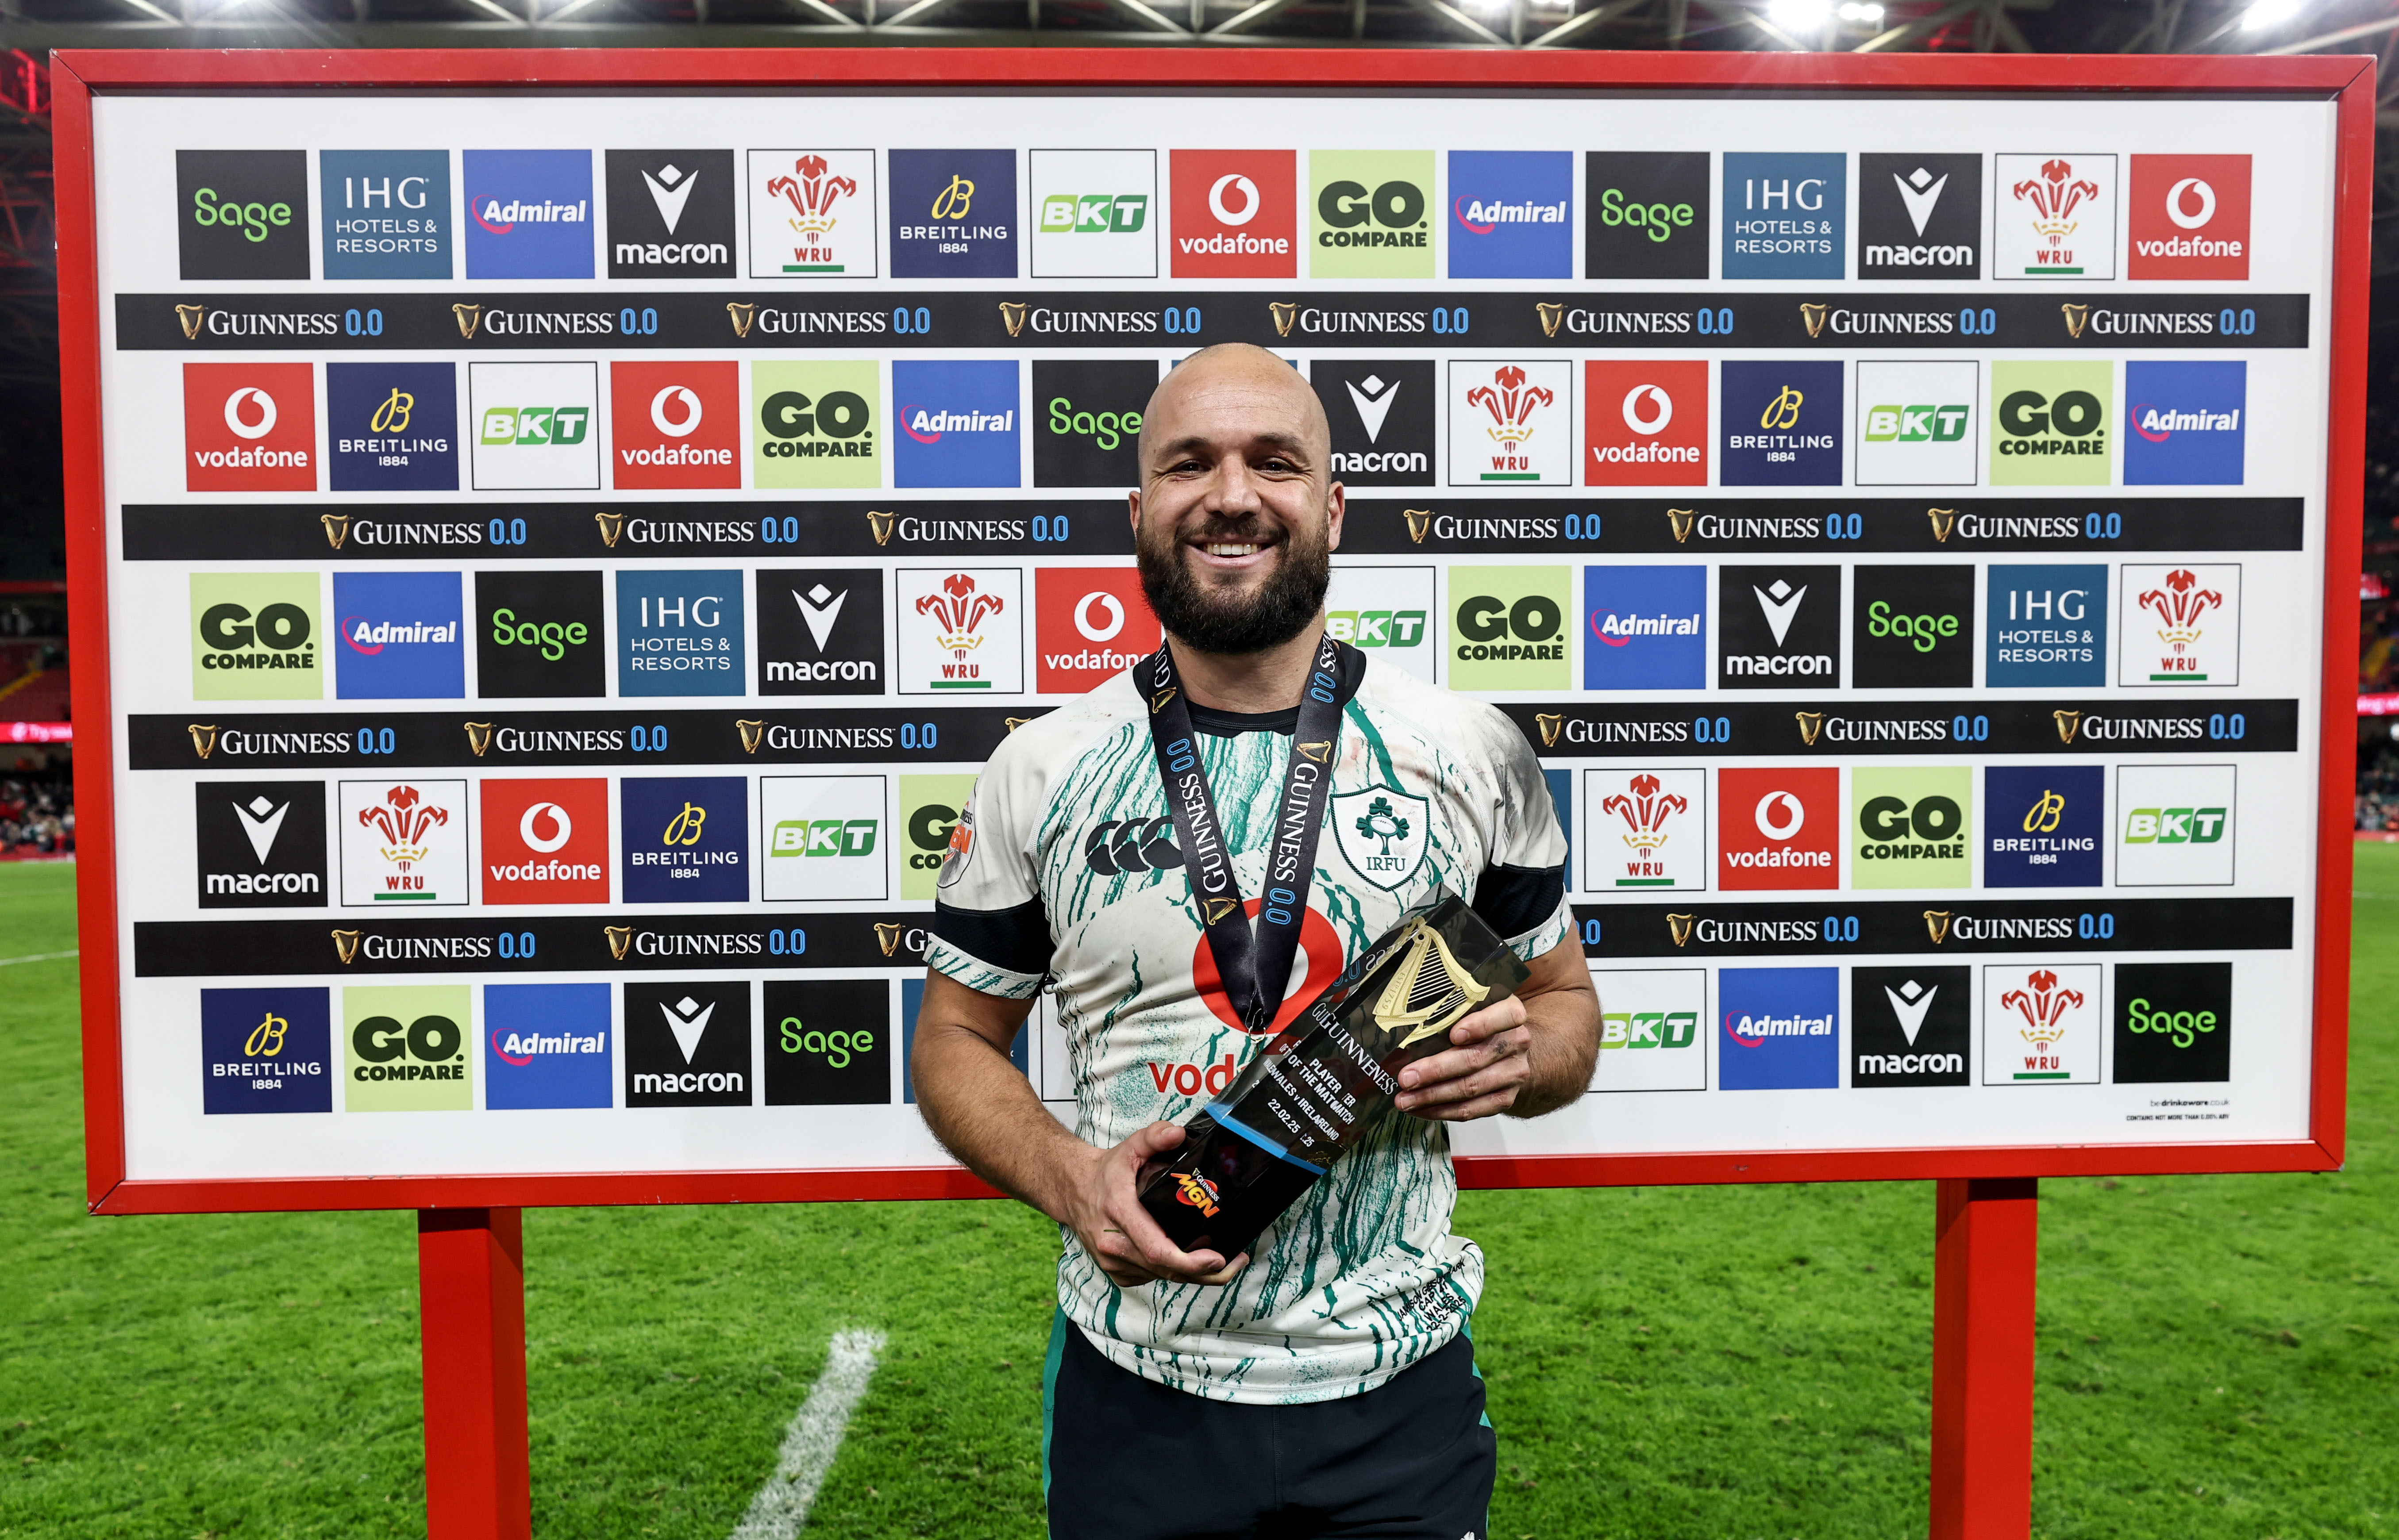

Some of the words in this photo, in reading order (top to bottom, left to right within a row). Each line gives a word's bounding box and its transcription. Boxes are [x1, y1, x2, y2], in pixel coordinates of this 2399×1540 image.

[346, 177, 426, 209] IHG
[1318, 181, 1427, 228] GO.
[1746, 179, 1823, 211] IHG
[195, 188, 293, 243] Sage
[483, 200, 586, 223] Admiral
[1042, 198, 1145, 229] BKT
[1466, 200, 1566, 223] Admiral
[1602, 189, 1694, 242] Sage
[336, 219, 420, 234] HOTELS
[424, 219, 437, 233] &
[900, 226, 1007, 239] BREITLING
[1735, 220, 1815, 234] HOTELS
[1819, 220, 1832, 234] &
[336, 238, 437, 253] RESORTS
[939, 243, 968, 253] 1884
[1179, 232, 1289, 254] vodafone
[1319, 231, 1426, 247] COMPARE
[1735, 239, 1832, 253] RESORTS
[795, 248, 831, 261] WRU
[1866, 246, 1973, 265] macron
[2037, 251, 2072, 264] WRU
[208, 310, 338, 335] GUINNESS
[345, 308, 383, 336] 0.0
[759, 308, 886, 333] GUINNESS
[893, 307, 931, 334] 0.0
[1031, 308, 1157, 333] GUINNESS
[1164, 307, 1201, 334] 0.0
[1567, 309, 1690, 333] GUINNESS
[1697, 307, 1734, 335] 0.0
[1830, 309, 1953, 334] GUINNESS
[1960, 307, 1996, 335] 0.0
[761, 391, 872, 439] GO.
[911, 410, 1013, 433] Admiral
[1049, 397, 1143, 450] Sage
[1999, 391, 2104, 437] GO.
[2141, 408, 2240, 431] Admiral
[483, 411, 586, 442] BKT
[339, 438, 447, 453] BREITLING
[763, 442, 872, 457] COMPARE
[1593, 442, 1700, 463] vodafone
[1730, 435, 1833, 449] BREITLING
[1999, 440, 2103, 455] COMPARE
[195, 445, 308, 468] vodafone
[379, 456, 408, 466] 1884
[621, 443, 732, 465] vodafone
[1492, 457, 1528, 470] WRU
[1767, 452, 1796, 462] 1884
[353, 520, 481, 545] GUINNESS
[489, 518, 527, 545] 0.0
[627, 519, 754, 543] GUINNESS
[762, 516, 799, 543] 0.0
[1433, 515, 1557, 539] GUINNESS
[1564, 514, 1601, 540] 0.0
[1697, 515, 1819, 538] GUINNESS
[1826, 513, 1862, 540] 0.0
[641, 596, 720, 627] IHG
[2009, 589, 2085, 621] IHG
[200, 603, 314, 650] GO.
[1457, 595, 1563, 642] GO.
[1601, 613, 1700, 636] Admiral
[1868, 600, 1959, 653] Sage
[353, 621, 456, 644] Admiral
[493, 608, 588, 661] Sage
[1999, 630, 2077, 644] HOTELS
[2081, 630, 2094, 644] &
[631, 638, 713, 652] HOTELS
[718, 637, 731, 651] &
[1457, 645, 1563, 661] COMPARE
[1998, 648, 2093, 663] RESORTS
[202, 653, 314, 669] COMPARE
[632, 656, 731, 671] RESORTS
[767, 661, 876, 681] macron
[943, 664, 978, 678] WRU
[1727, 655, 1832, 675] macron
[2162, 658, 2195, 671] WRU
[1310, 672, 1336, 703] 0.0
[496, 728, 623, 752] GUINNESS
[631, 725, 667, 752] 0.0
[1566, 719, 1687, 742] GUINNESS
[1694, 717, 1730, 743] 0.0
[1825, 718, 1946, 741] GUINNESS
[1953, 715, 1989, 741] 0.0
[221, 730, 350, 754] GUINNESS
[358, 727, 395, 754] 0.0
[1167, 738, 1194, 772] 0.0
[1275, 762, 1319, 883] GUINNESS
[1860, 796, 1964, 841] GO.
[2127, 811, 2224, 841] BKT
[1179, 773, 1227, 893] GUINNESS
[1993, 837, 2094, 852] BREITLING
[632, 851, 738, 865] BREITLING
[1726, 846, 1832, 868] vodafone
[1860, 844, 1963, 859] COMPARE
[2029, 854, 2057, 864] 1884
[490, 860, 601, 881] vodafone
[671, 868, 700, 879] 1884
[1366, 856, 1406, 872] IRFU
[1628, 863, 1662, 876] WRU
[207, 873, 319, 894] macron
[386, 876, 423, 890] WRU
[1265, 887, 1296, 925] 0.0
[1575, 919, 1601, 945] .0
[1953, 916, 2072, 939] GUINNESS
[2079, 913, 2114, 939] 0.0
[363, 935, 491, 959] GUINNESS
[498, 932, 535, 959] 0.0
[635, 932, 762, 955] GUINNESS
[769, 929, 806, 955] 0.0
[1382, 989, 1396, 1010] 1759
[1601, 1015, 1695, 1045] BKT
[2129, 998, 2216, 1048] Sage
[353, 1015, 464, 1063] GO.
[503, 1032, 605, 1055] Admiral
[780, 1017, 874, 1068] Sage
[213, 1062, 321, 1077] BREITLING
[354, 1065, 464, 1081] COMPARE
[1287, 1055, 1300, 1071] OF
[1298, 1063, 1317, 1087] THE
[1859, 1054, 1963, 1074] macron
[2025, 1057, 2058, 1069] WRU
[252, 1079, 282, 1090] 1884
[634, 1073, 743, 1093] macron
[1309, 1058, 1342, 1093] PLAYER
[1267, 1098, 1301, 1133] 22.02.25
[1196, 1175, 1220, 1202] GUINNESS
[1397, 1291, 1423, 1322] JAMISON
[1418, 1291, 1435, 1311] CAP
[1424, 1292, 1455, 1322] WALES
